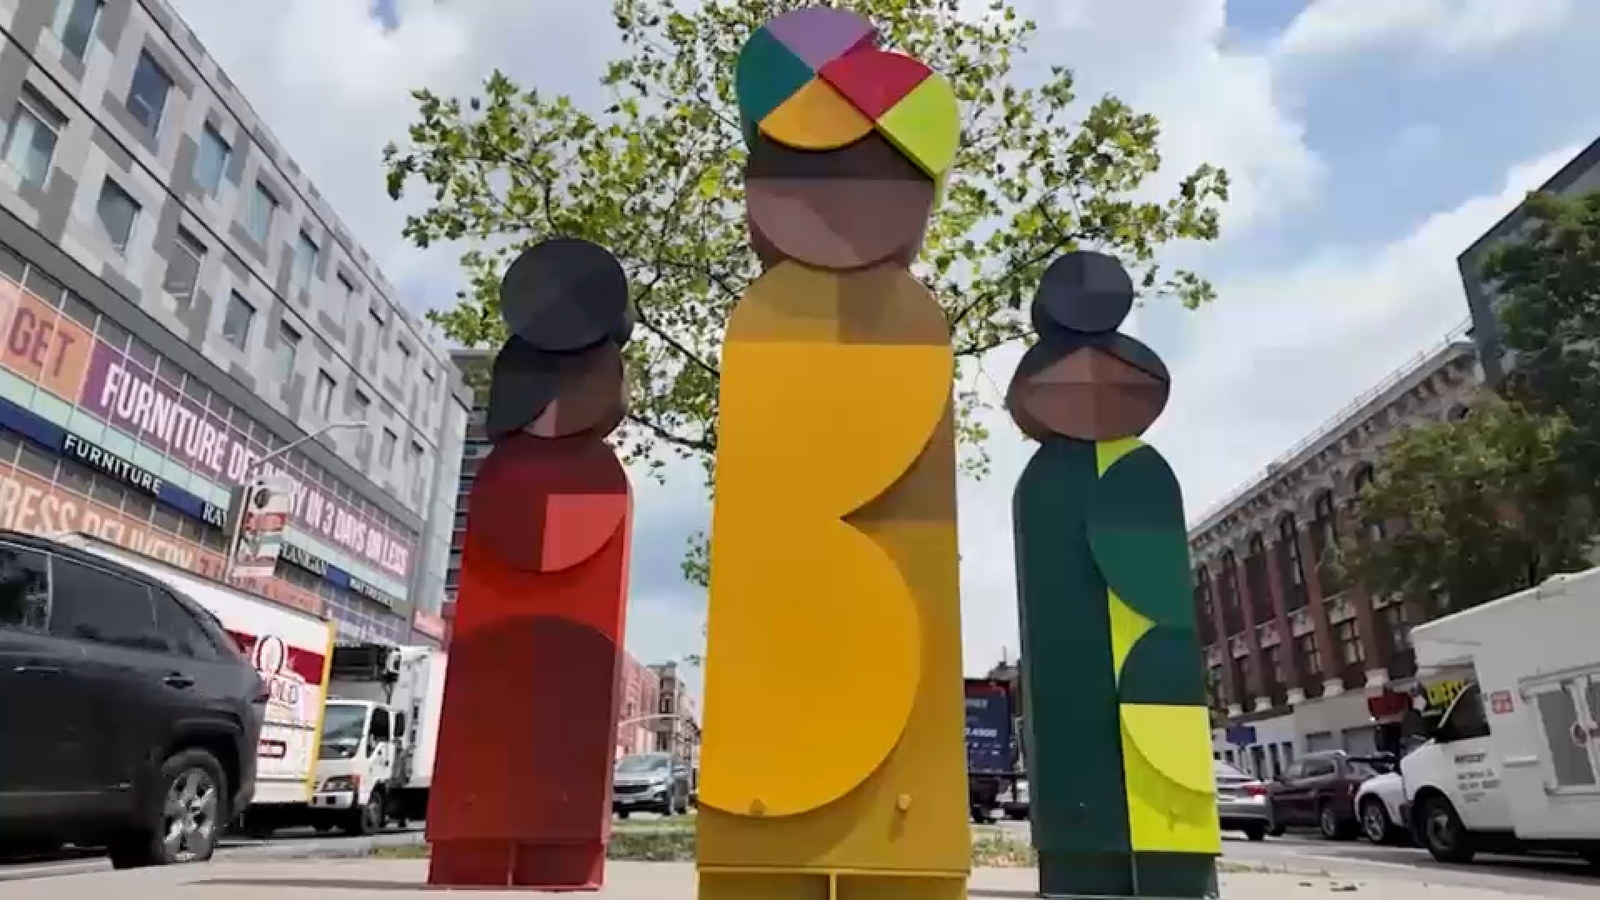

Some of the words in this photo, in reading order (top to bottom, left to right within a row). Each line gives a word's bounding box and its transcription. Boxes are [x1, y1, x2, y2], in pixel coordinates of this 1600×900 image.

[7, 306, 75, 378] GET
[101, 362, 230, 473] FURNITURE
[322, 501, 336, 536] 3
[334, 507, 368, 553] DAYS
[63, 434, 163, 496] FURNITURE
